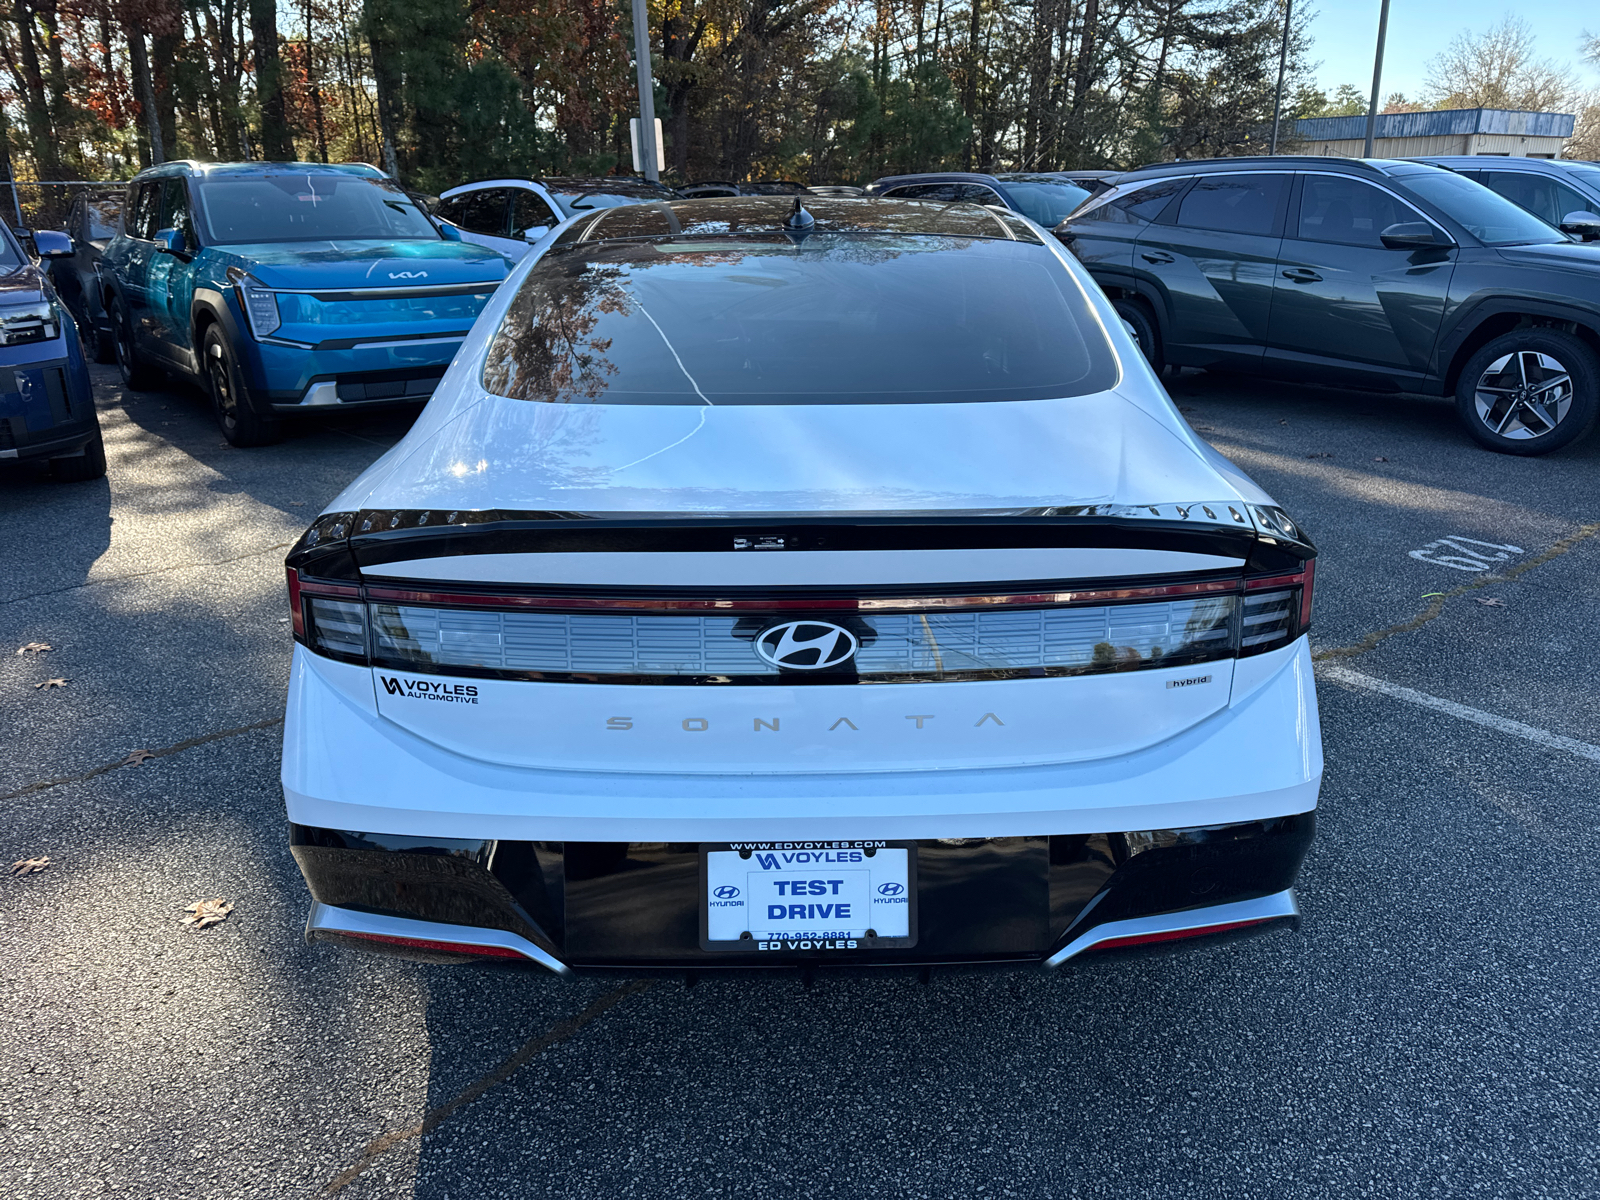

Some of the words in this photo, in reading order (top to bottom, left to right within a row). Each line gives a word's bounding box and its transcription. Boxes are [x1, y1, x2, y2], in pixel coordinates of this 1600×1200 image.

[1173, 676, 1207, 687] hybrid
[404, 679, 478, 697] VOYLES
[407, 691, 478, 704] AUTOMOTIVE
[606, 712, 1005, 732] SONATA
[730, 841, 886, 850] WWW.EDVOYLES.COM
[782, 851, 862, 863] VOYLES
[773, 880, 844, 896] TEST
[767, 903, 851, 919] DRIVE
[767, 931, 851, 941] 770-952-8881
[758, 941, 782, 951] ED
[787, 940, 857, 950] VOYLES
